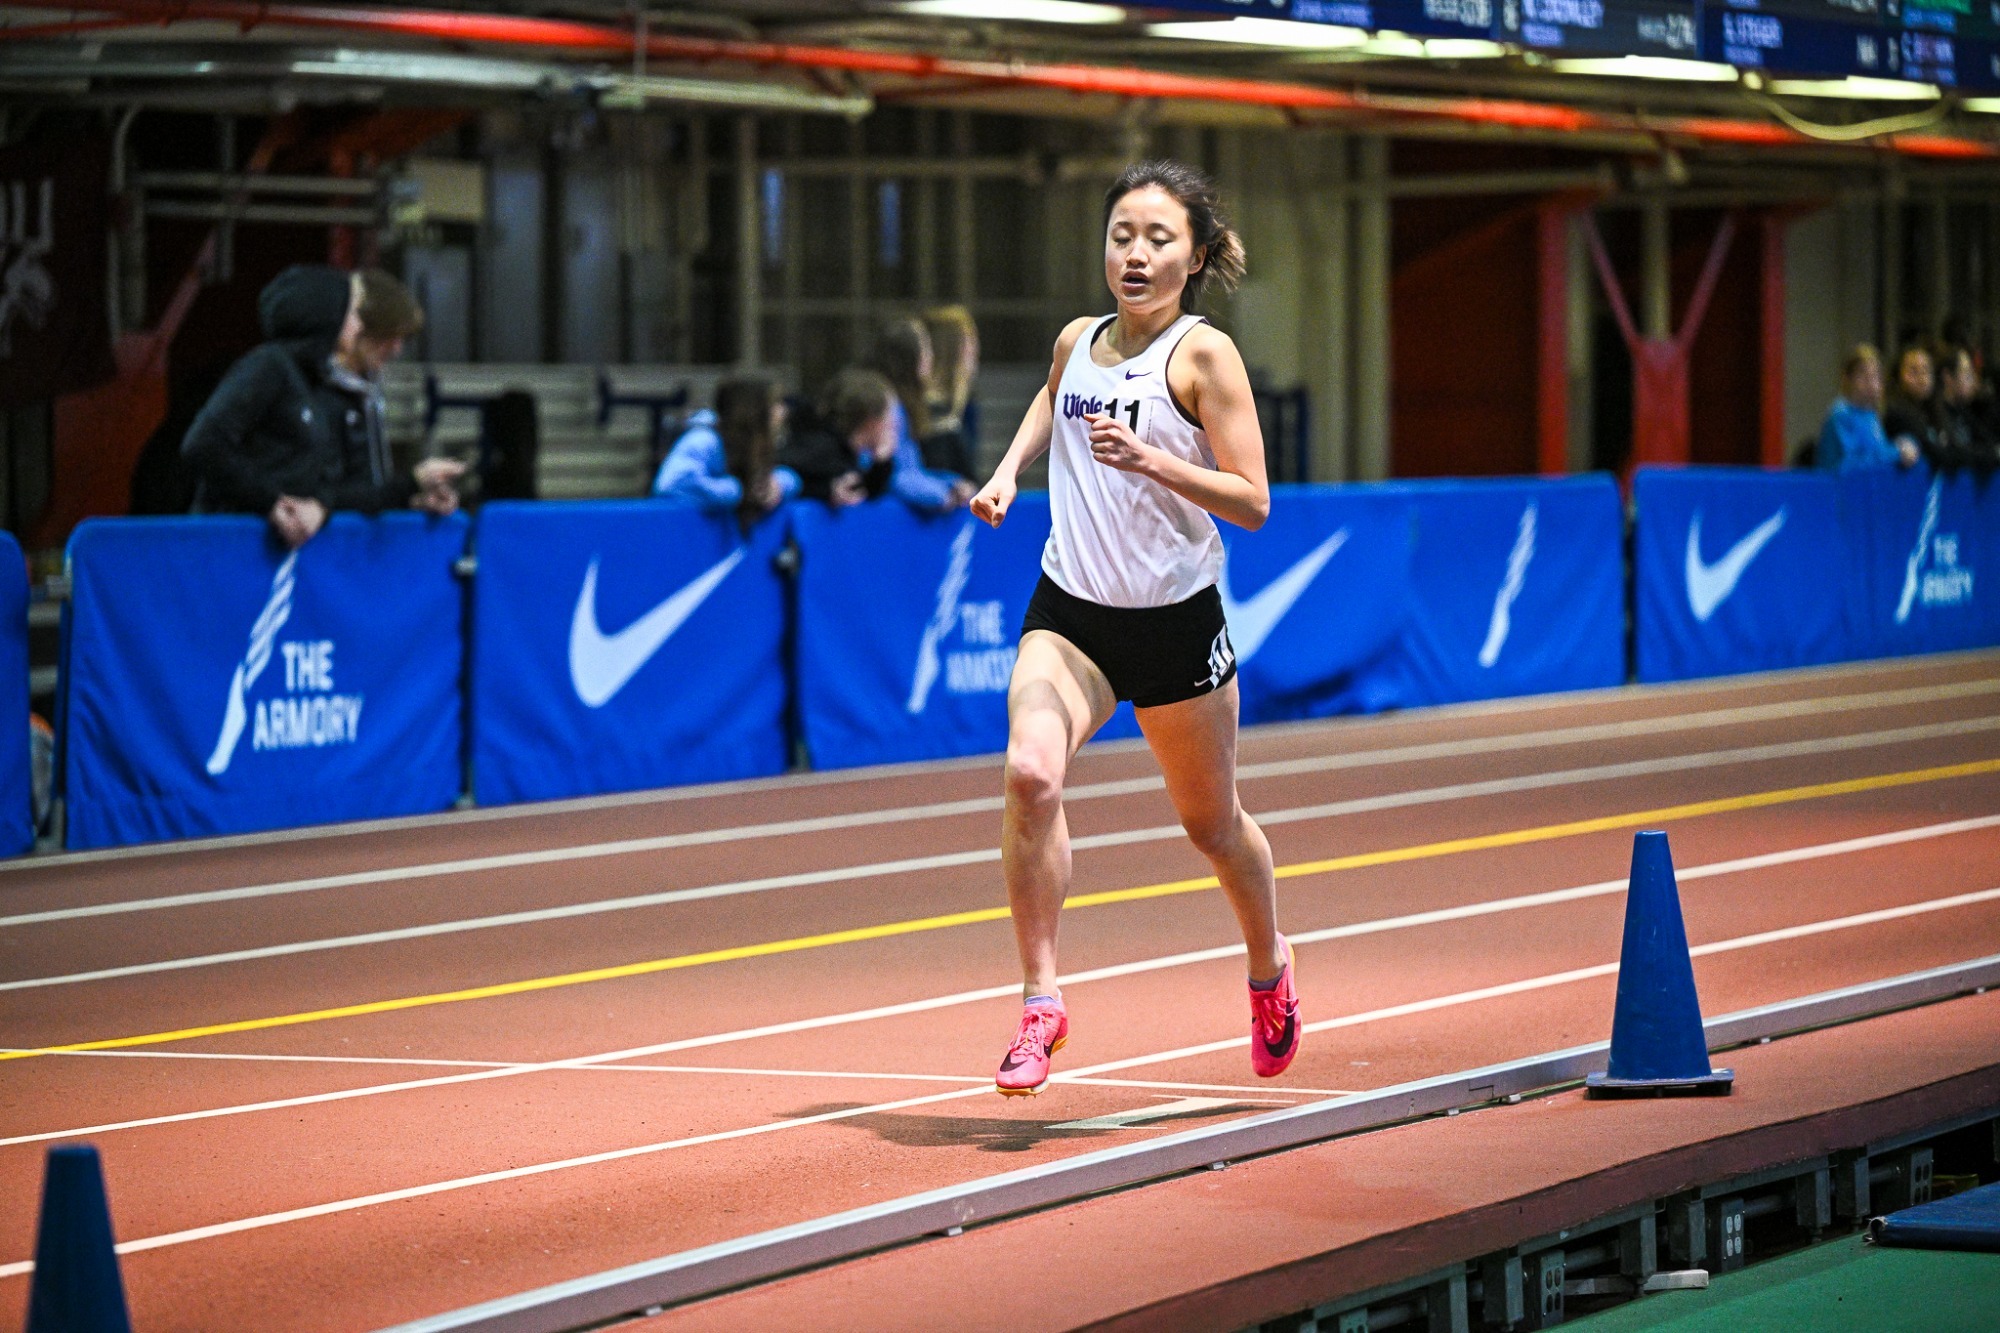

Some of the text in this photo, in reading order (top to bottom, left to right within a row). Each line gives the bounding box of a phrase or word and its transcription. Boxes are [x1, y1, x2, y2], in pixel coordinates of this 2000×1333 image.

[1104, 398, 1140, 435] 11
[281, 640, 335, 692] THE
[253, 694, 364, 752] ARMORY
